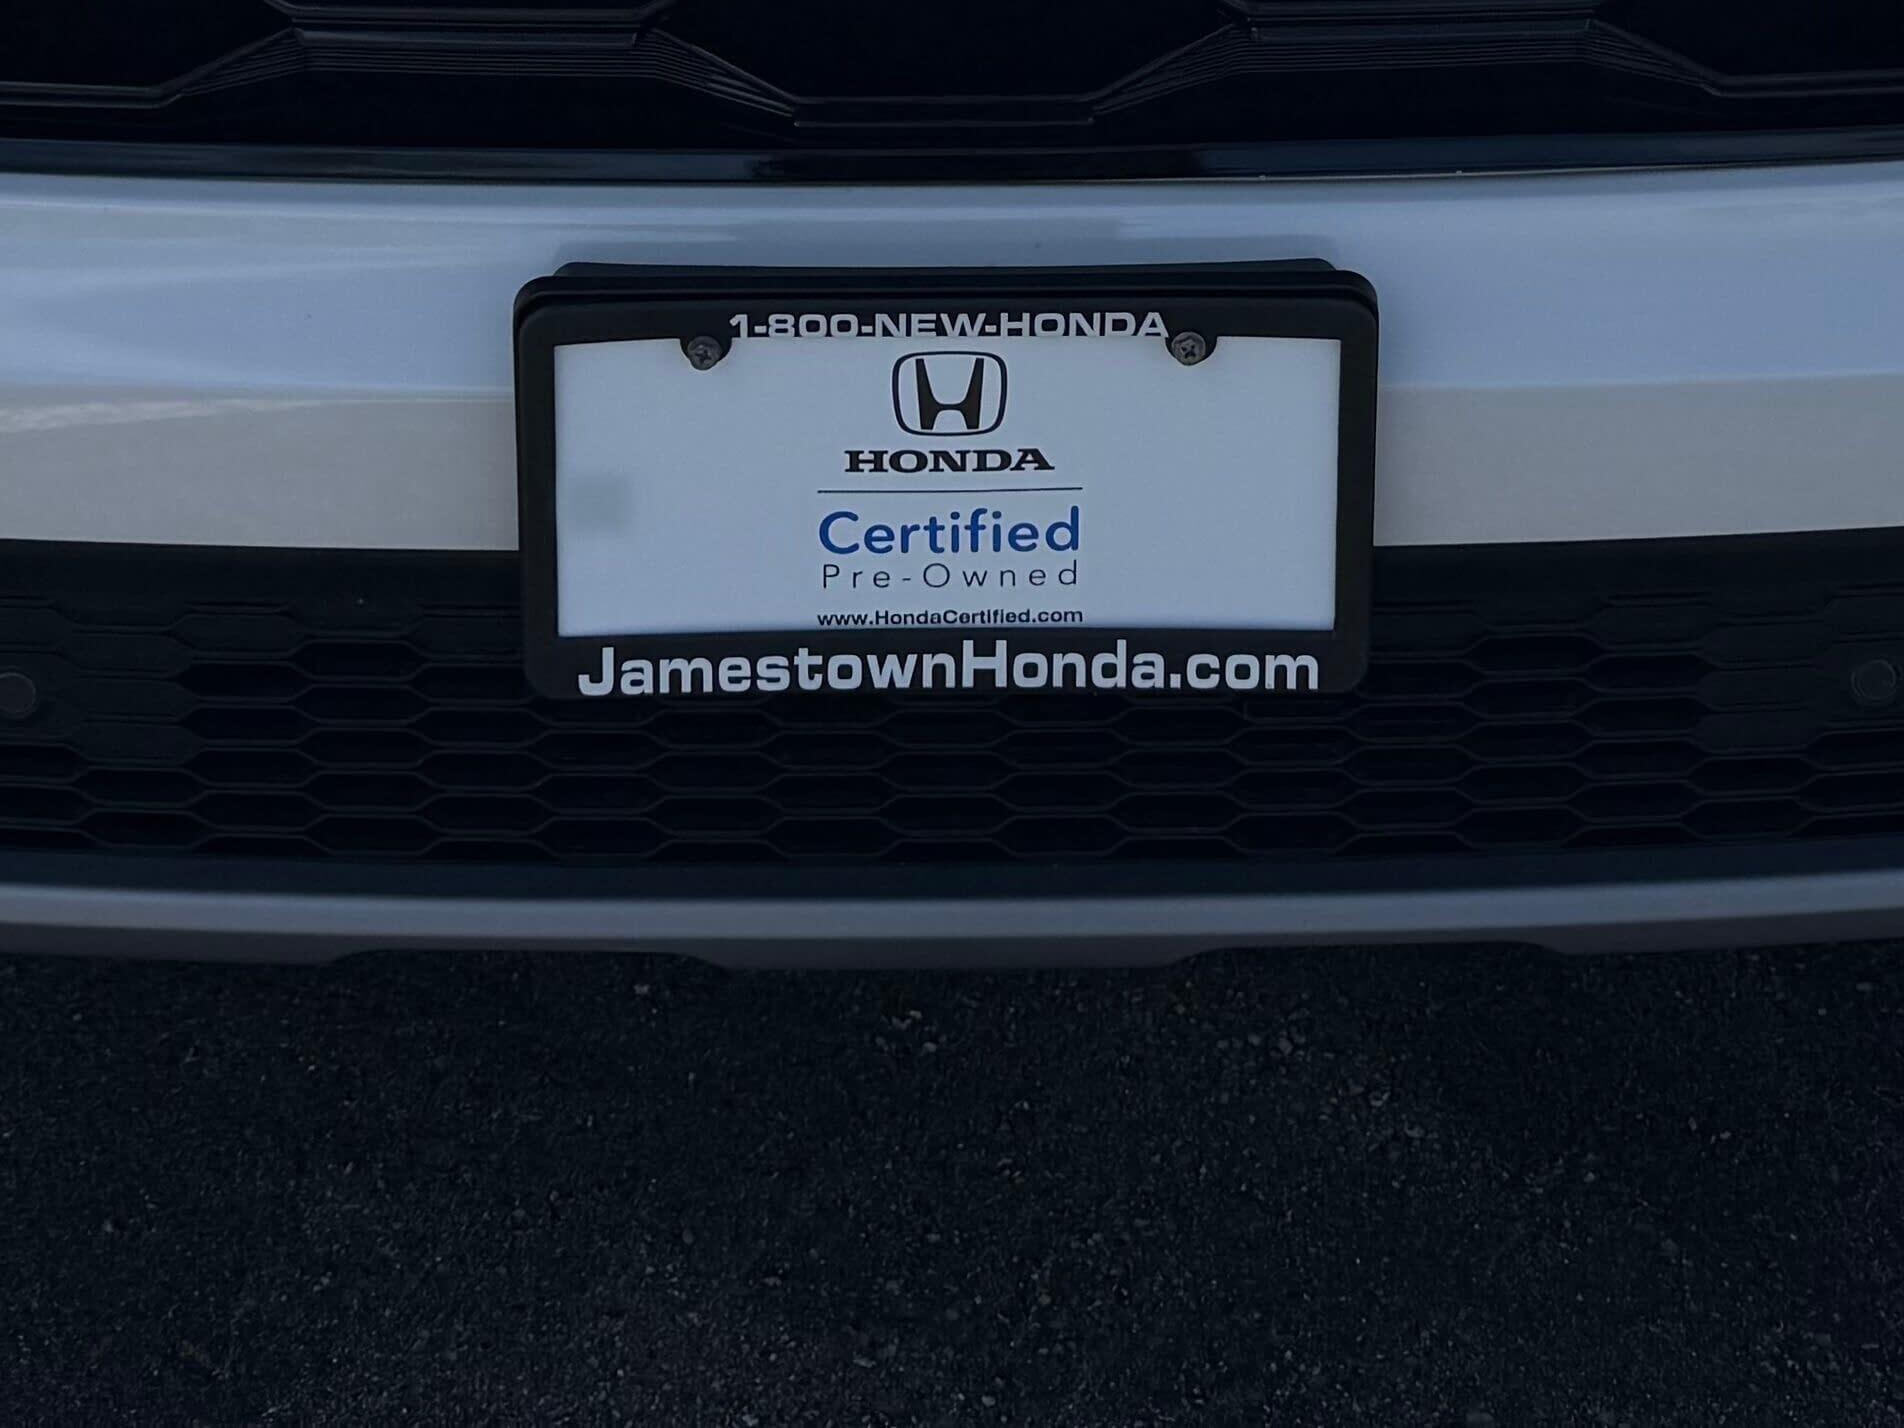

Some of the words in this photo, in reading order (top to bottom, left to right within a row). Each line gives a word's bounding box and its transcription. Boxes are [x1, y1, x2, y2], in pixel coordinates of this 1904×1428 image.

[729, 311, 1170, 339] 1-800-NEW-HONDA
[844, 447, 1056, 474] HONDA
[818, 505, 1080, 555] Certified
[822, 559, 1078, 589] Pre-Owned
[817, 608, 1084, 627] www.HondaCertified.com
[578, 639, 1319, 696] JamestownHonda.com
